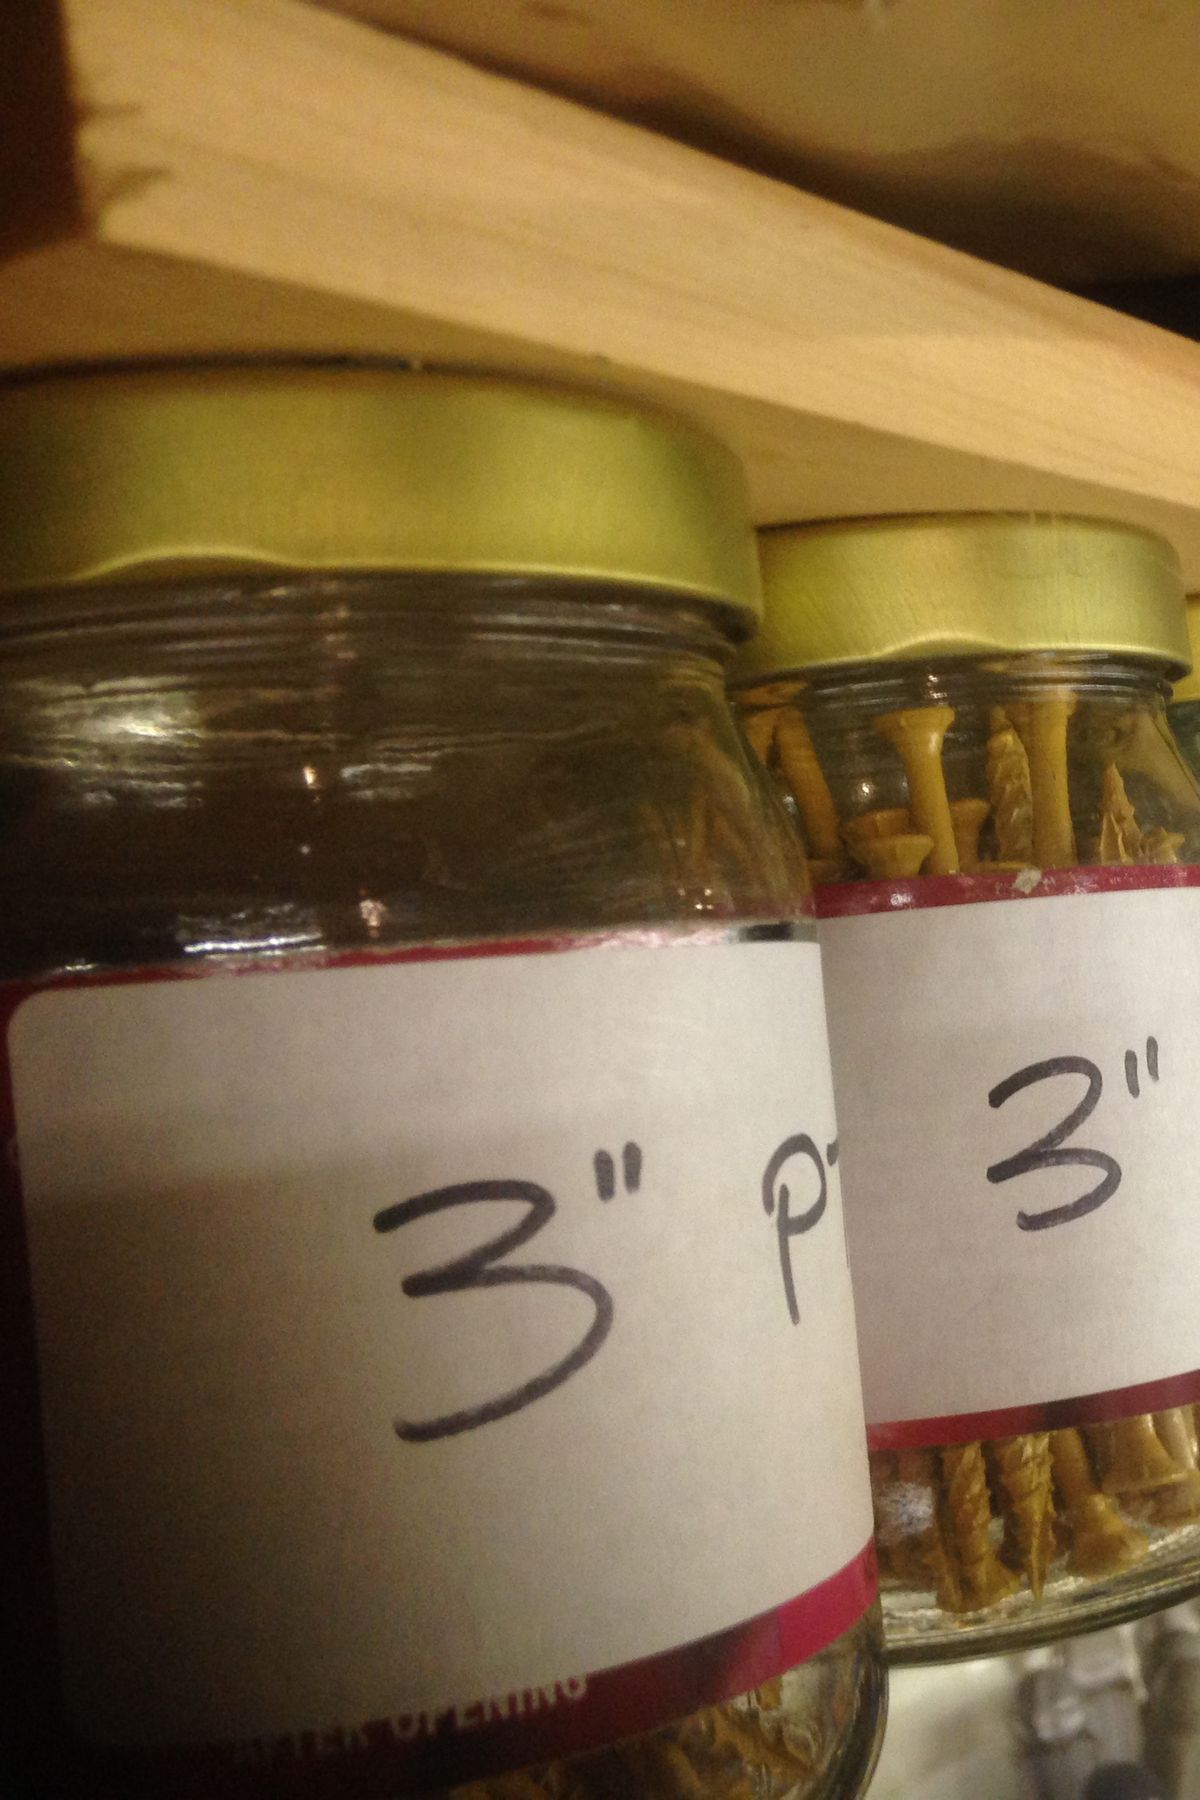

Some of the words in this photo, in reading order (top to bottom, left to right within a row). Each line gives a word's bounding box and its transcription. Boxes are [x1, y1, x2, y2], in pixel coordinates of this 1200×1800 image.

[985, 1035, 1160, 1233] 3"
[373, 1141, 643, 1444] 3"
[760, 1132, 841, 1326] P
